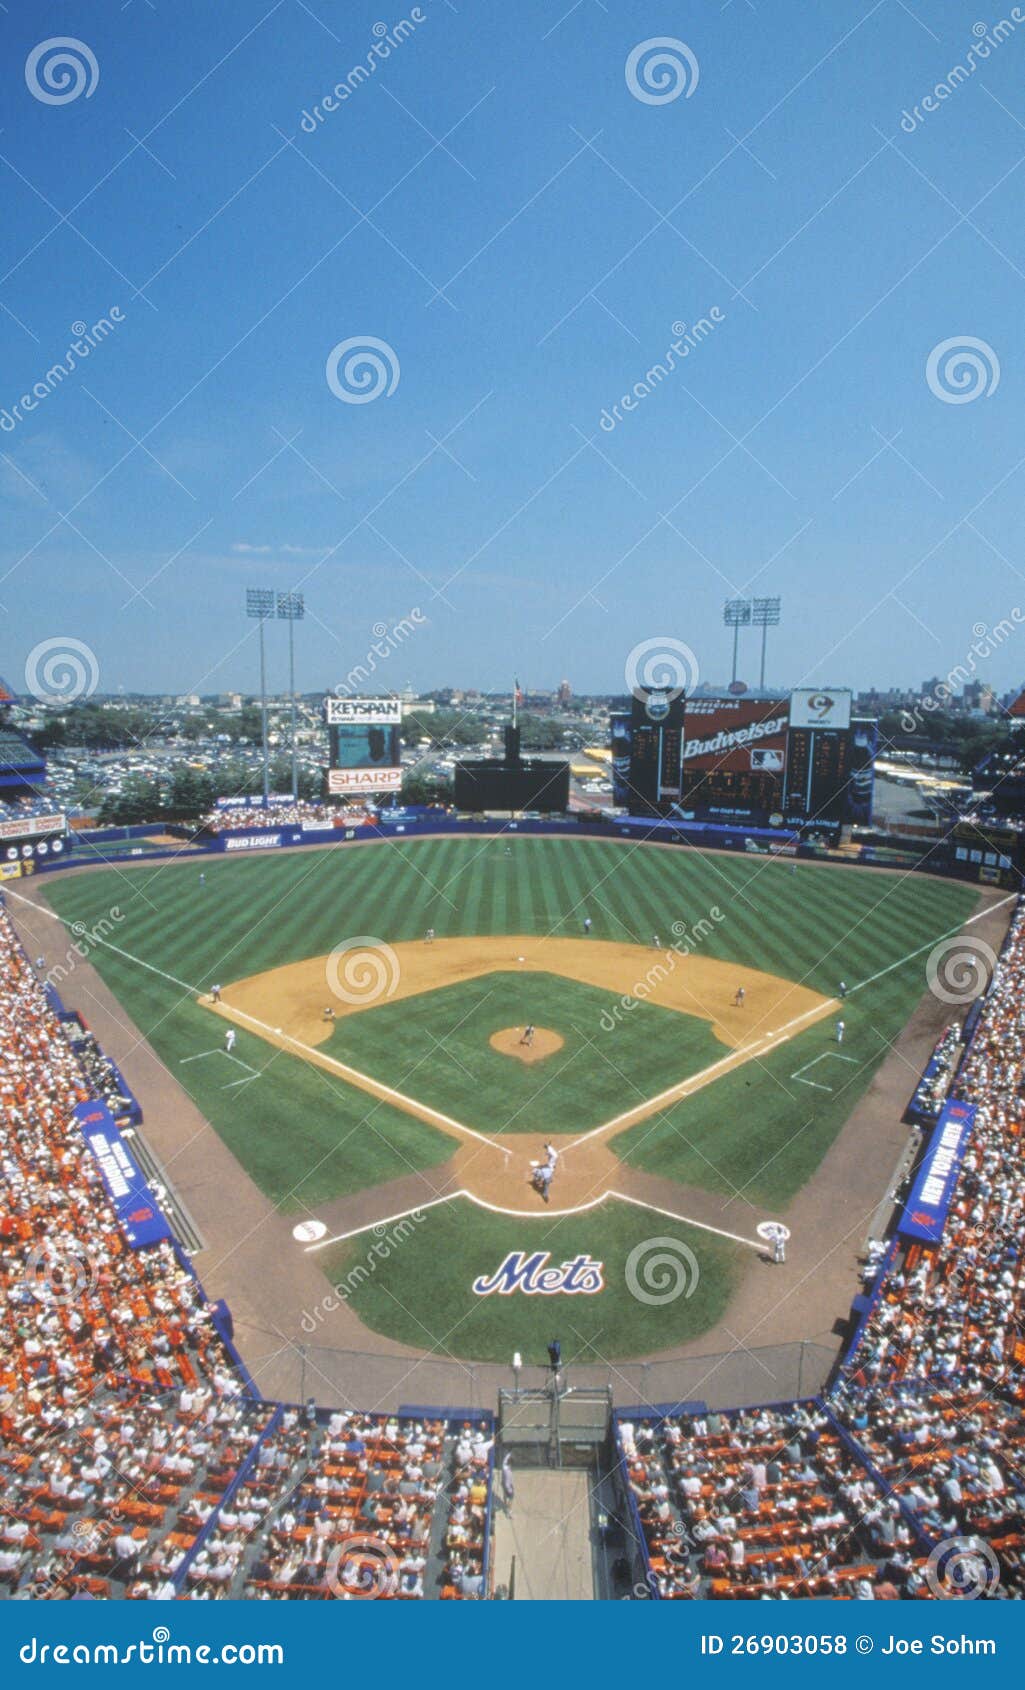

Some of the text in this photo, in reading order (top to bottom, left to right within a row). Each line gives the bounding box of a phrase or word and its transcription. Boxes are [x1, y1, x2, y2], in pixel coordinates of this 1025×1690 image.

[331, 702, 399, 714] KEYSPAN
[683, 716, 788, 758] Budweiser
[331, 771, 400, 785] SHARP
[226, 837, 249, 849] BUD
[250, 835, 280, 846] LIGHT
[920, 1122, 963, 1205] NEW YORK METS
[472, 1251, 604, 1295] Mets
